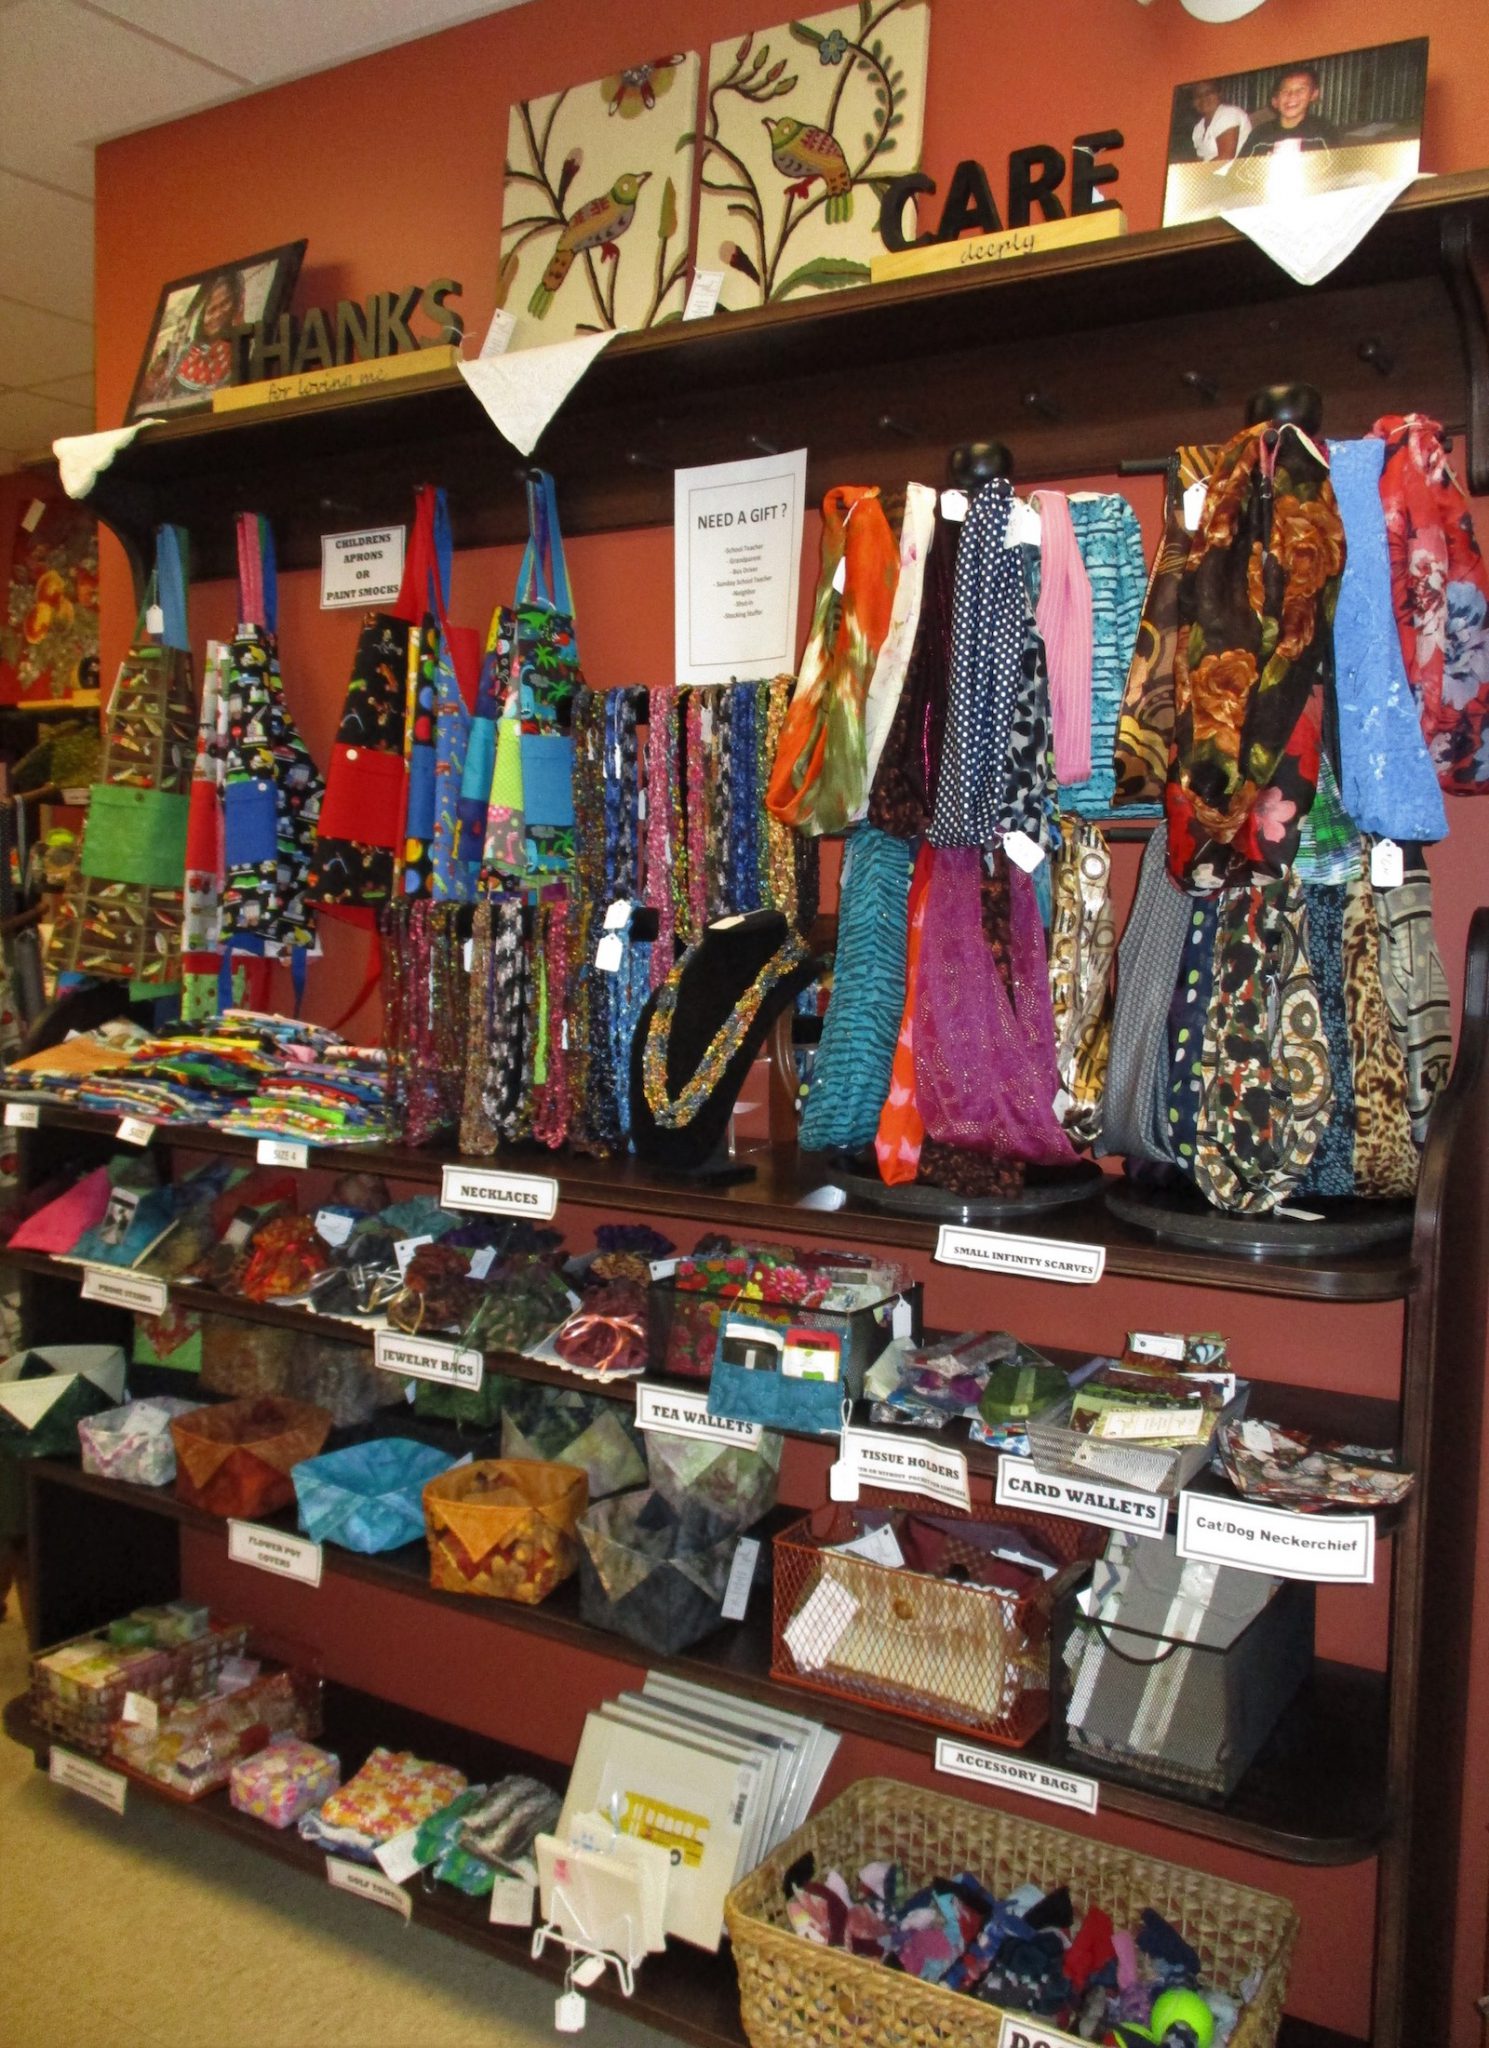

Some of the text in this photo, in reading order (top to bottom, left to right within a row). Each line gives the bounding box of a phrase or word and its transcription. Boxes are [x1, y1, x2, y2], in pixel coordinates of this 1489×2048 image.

[880, 129, 1124, 253] CARE
[960, 233, 1036, 264] deeply
[220, 278, 464, 387] THANKS
[269, 383, 292, 402] for
[697, 503, 788, 530] NEED A GIFT ?
[335, 533, 391, 550] CHILDRENS
[343, 550, 384, 565] APRONS
[355, 569, 370, 580] OR
[326, 584, 399, 601] PAINT SMOCKS
[273, 1150, 289, 1161] SIZE
[460, 1185, 539, 1205] NECKLACES
[953, 1246, 1094, 1275] SMALL INFINITY SCARVES
[383, 1349, 474, 1377] JEWELRY BAGS
[652, 1404, 754, 1435] TEA WALLETS
[861, 1449, 960, 1480] TISSUE HOLDERS
[1008, 1477, 1157, 1520] CARD WALLETS
[248, 1535, 301, 1559] FLOWER POT
[1196, 1516, 1358, 1552] Cat/Dog Neckerchief
[257, 1552, 291, 1569] COVERS
[955, 1752, 1078, 1794] ACCESSORY BAGS
